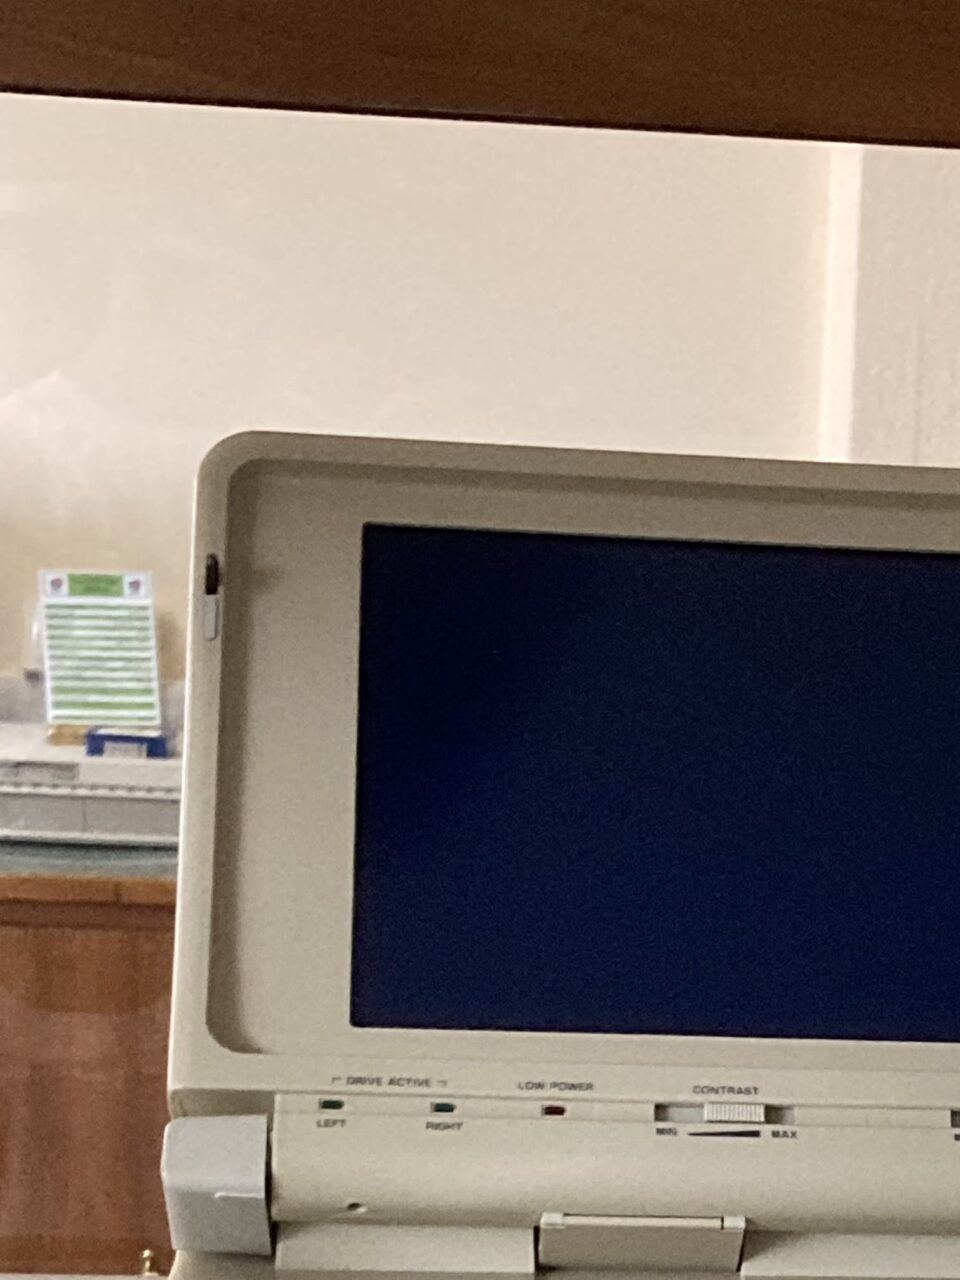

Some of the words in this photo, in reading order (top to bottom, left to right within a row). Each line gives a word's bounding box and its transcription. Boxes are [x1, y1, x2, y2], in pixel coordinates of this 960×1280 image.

[550, 1082, 594, 1091] POWER
[692, 1085, 758, 1095] CONTRAST
[316, 1119, 346, 1128] LEFT
[772, 1130, 797, 1138] MAX
